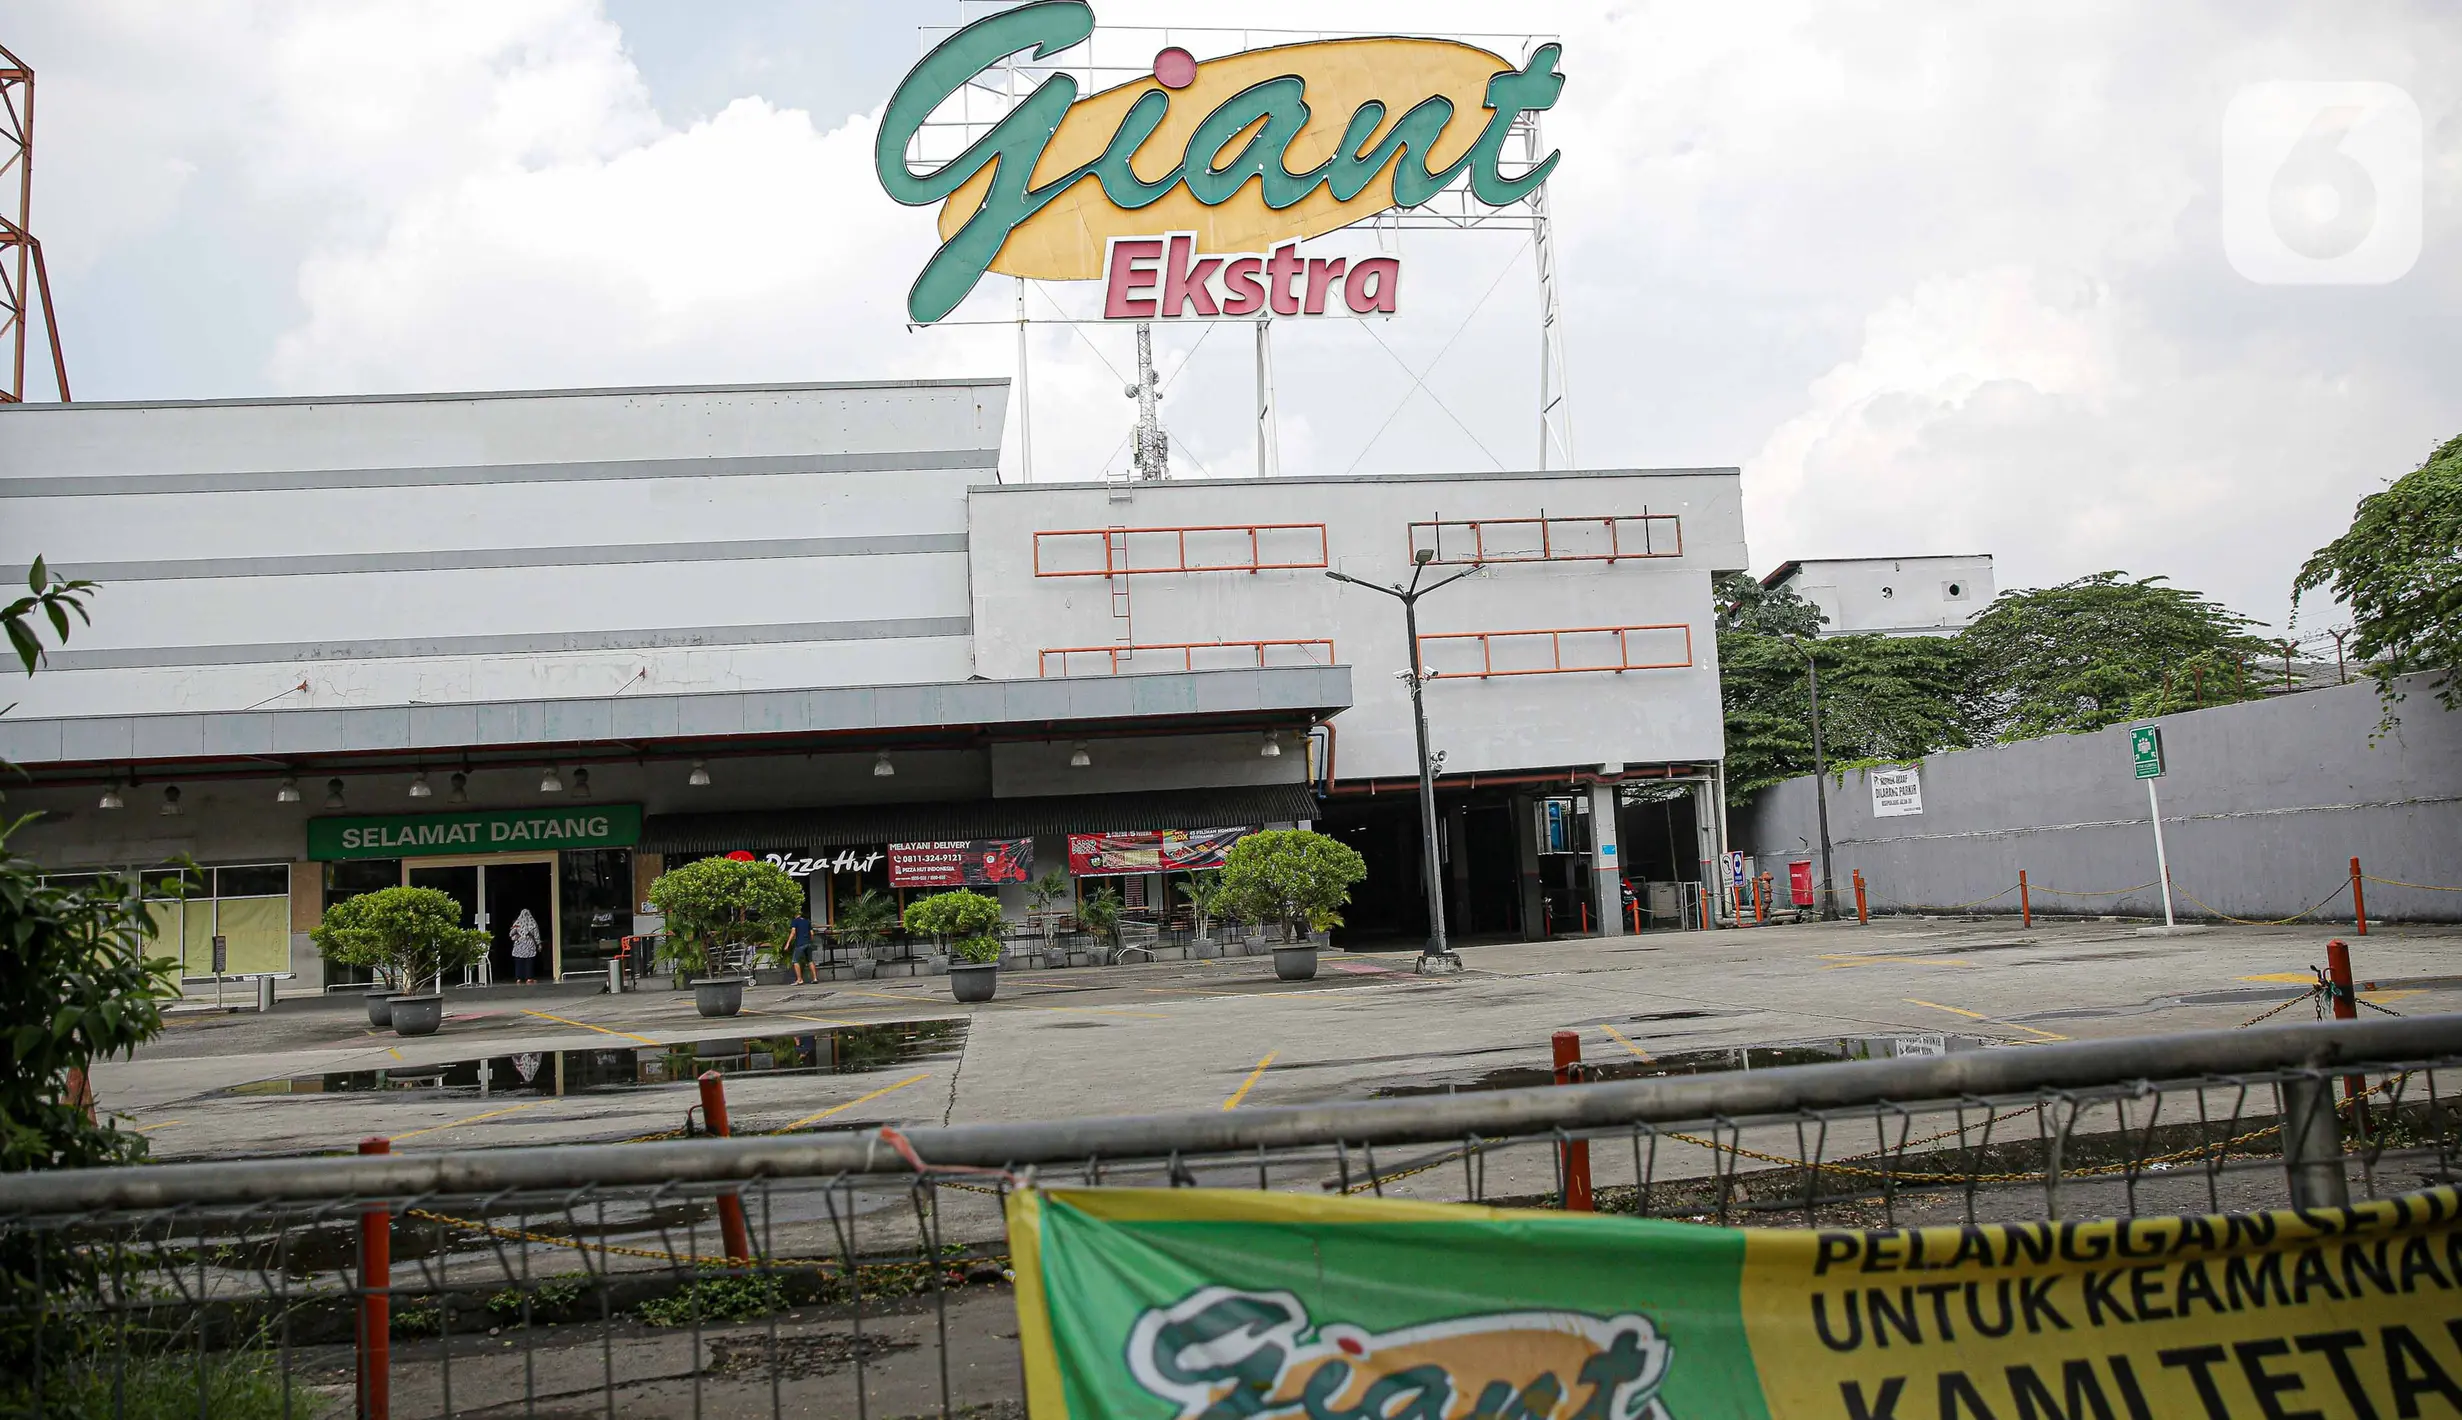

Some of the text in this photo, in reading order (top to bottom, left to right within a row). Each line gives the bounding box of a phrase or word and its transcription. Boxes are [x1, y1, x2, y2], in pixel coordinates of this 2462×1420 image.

[1103, 235, 1400, 319] Ekstra
[1875, 784, 1917, 798] DILARANG PARKIR
[342, 817, 609, 848] SELAMAT DATANG
[889, 841, 971, 850] MELAYANI DELIVERY
[765, 850, 885, 876] Pizza Hut
[903, 853, 962, 863] 0811-324-9121
[1813, 1211, 2276, 1276] PELANGGAN
[1811, 1273, 2073, 1352] UNTUK
[2157, 1319, 2462, 1420] TETA
